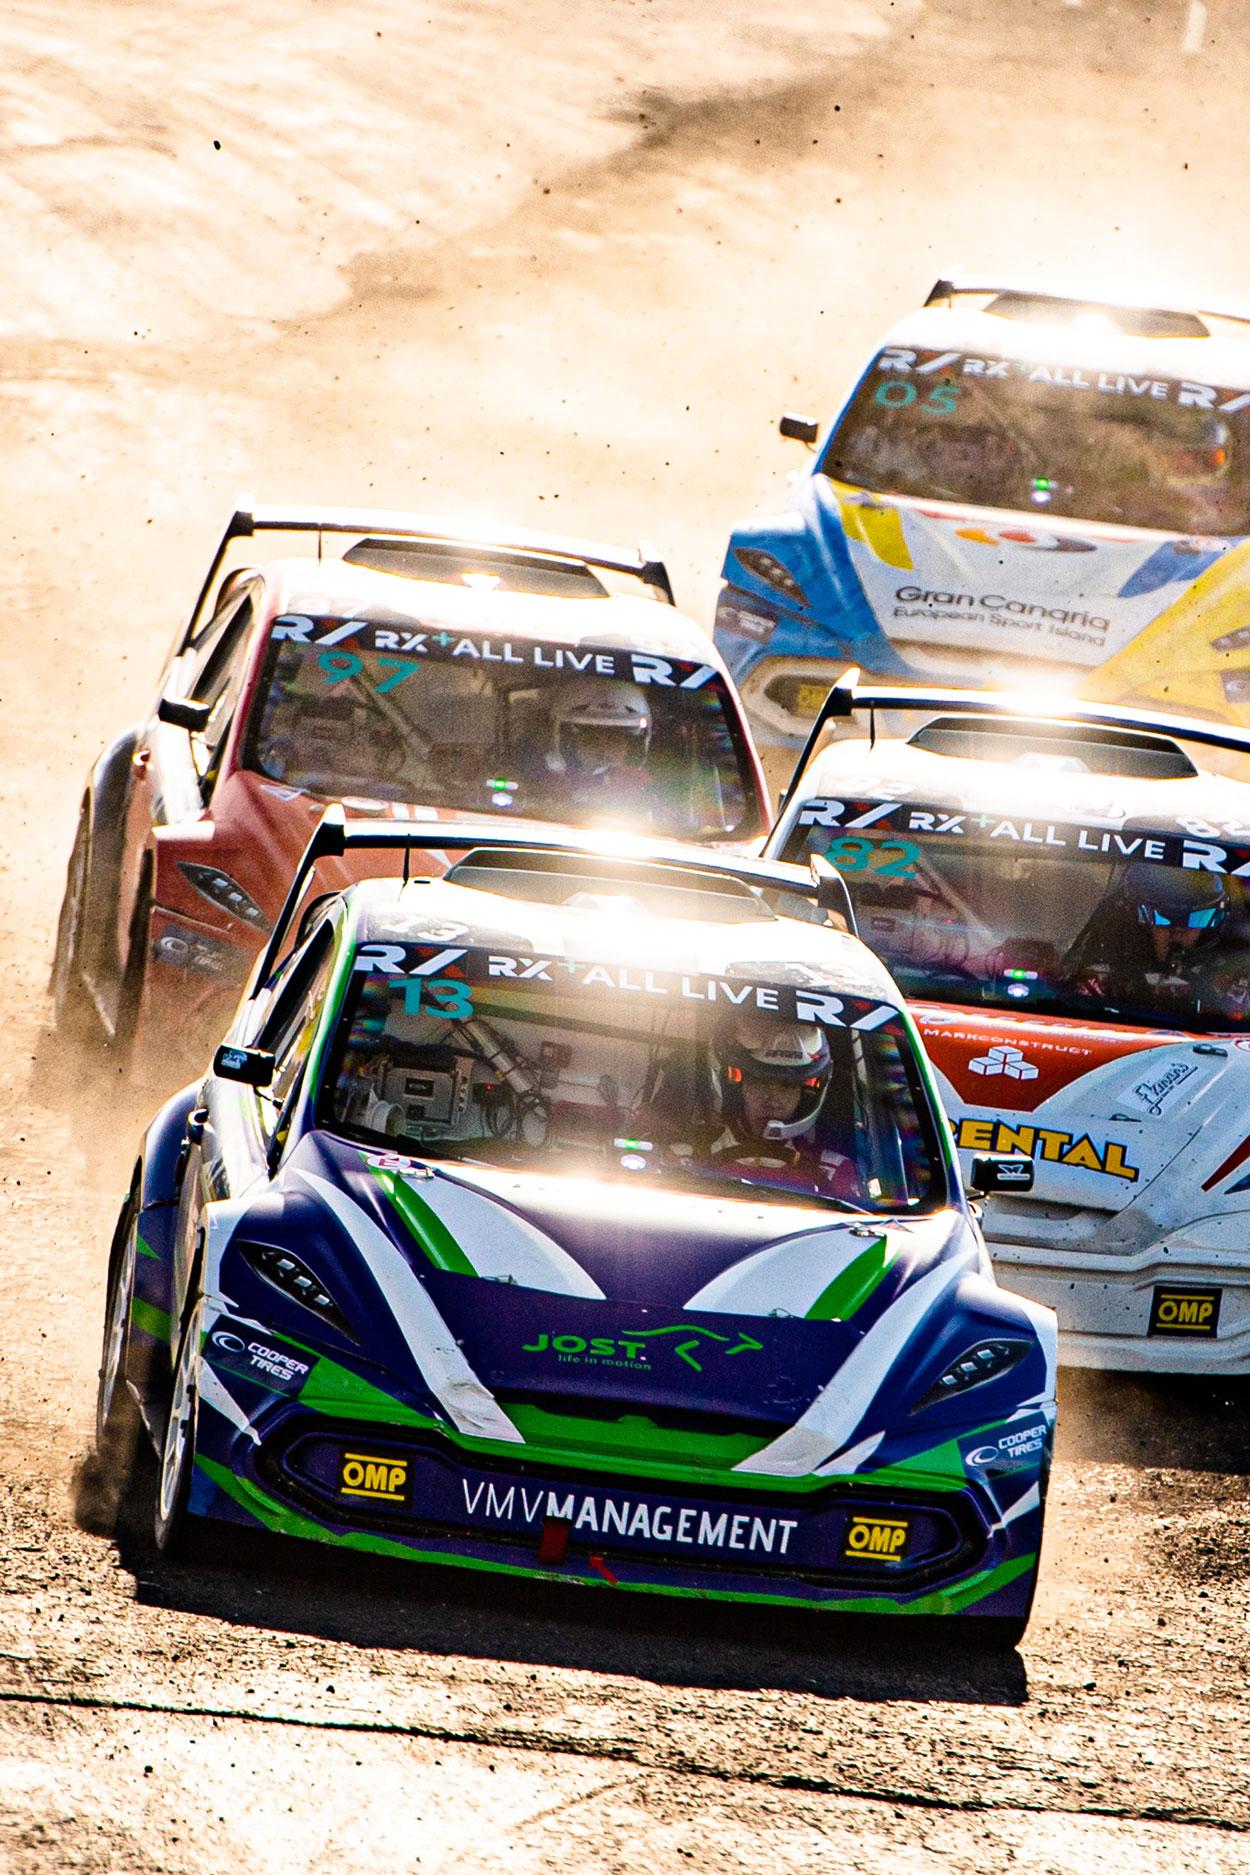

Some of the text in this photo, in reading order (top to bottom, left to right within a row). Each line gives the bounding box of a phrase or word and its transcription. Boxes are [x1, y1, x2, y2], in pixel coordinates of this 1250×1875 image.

[1098, 375, 1168, 399] LIVE
[896, 585, 1110, 632] Gran Canaria
[893, 606, 1106, 647] European Sport Island
[316, 651, 421, 694] 97
[534, 647, 615, 674] LIVE
[824, 836, 921, 880] 82
[1078, 830, 1166, 860] LIVE
[388, 979, 473, 1019] 13
[681, 979, 780, 1010] LIVE
[923, 1028, 1093, 1056] MARKCONSTRUCT
[1158, 1301, 1214, 1323] OMP
[247, 1341, 309, 1376] COOPER
[250, 1353, 294, 1381] TIRES
[558, 1353, 652, 1371] life in motion
[998, 1424, 1048, 1450] COOPER
[1008, 1439, 1043, 1459] TIRES
[342, 1463, 407, 1493] OMP
[848, 1525, 907, 1554] OMP
